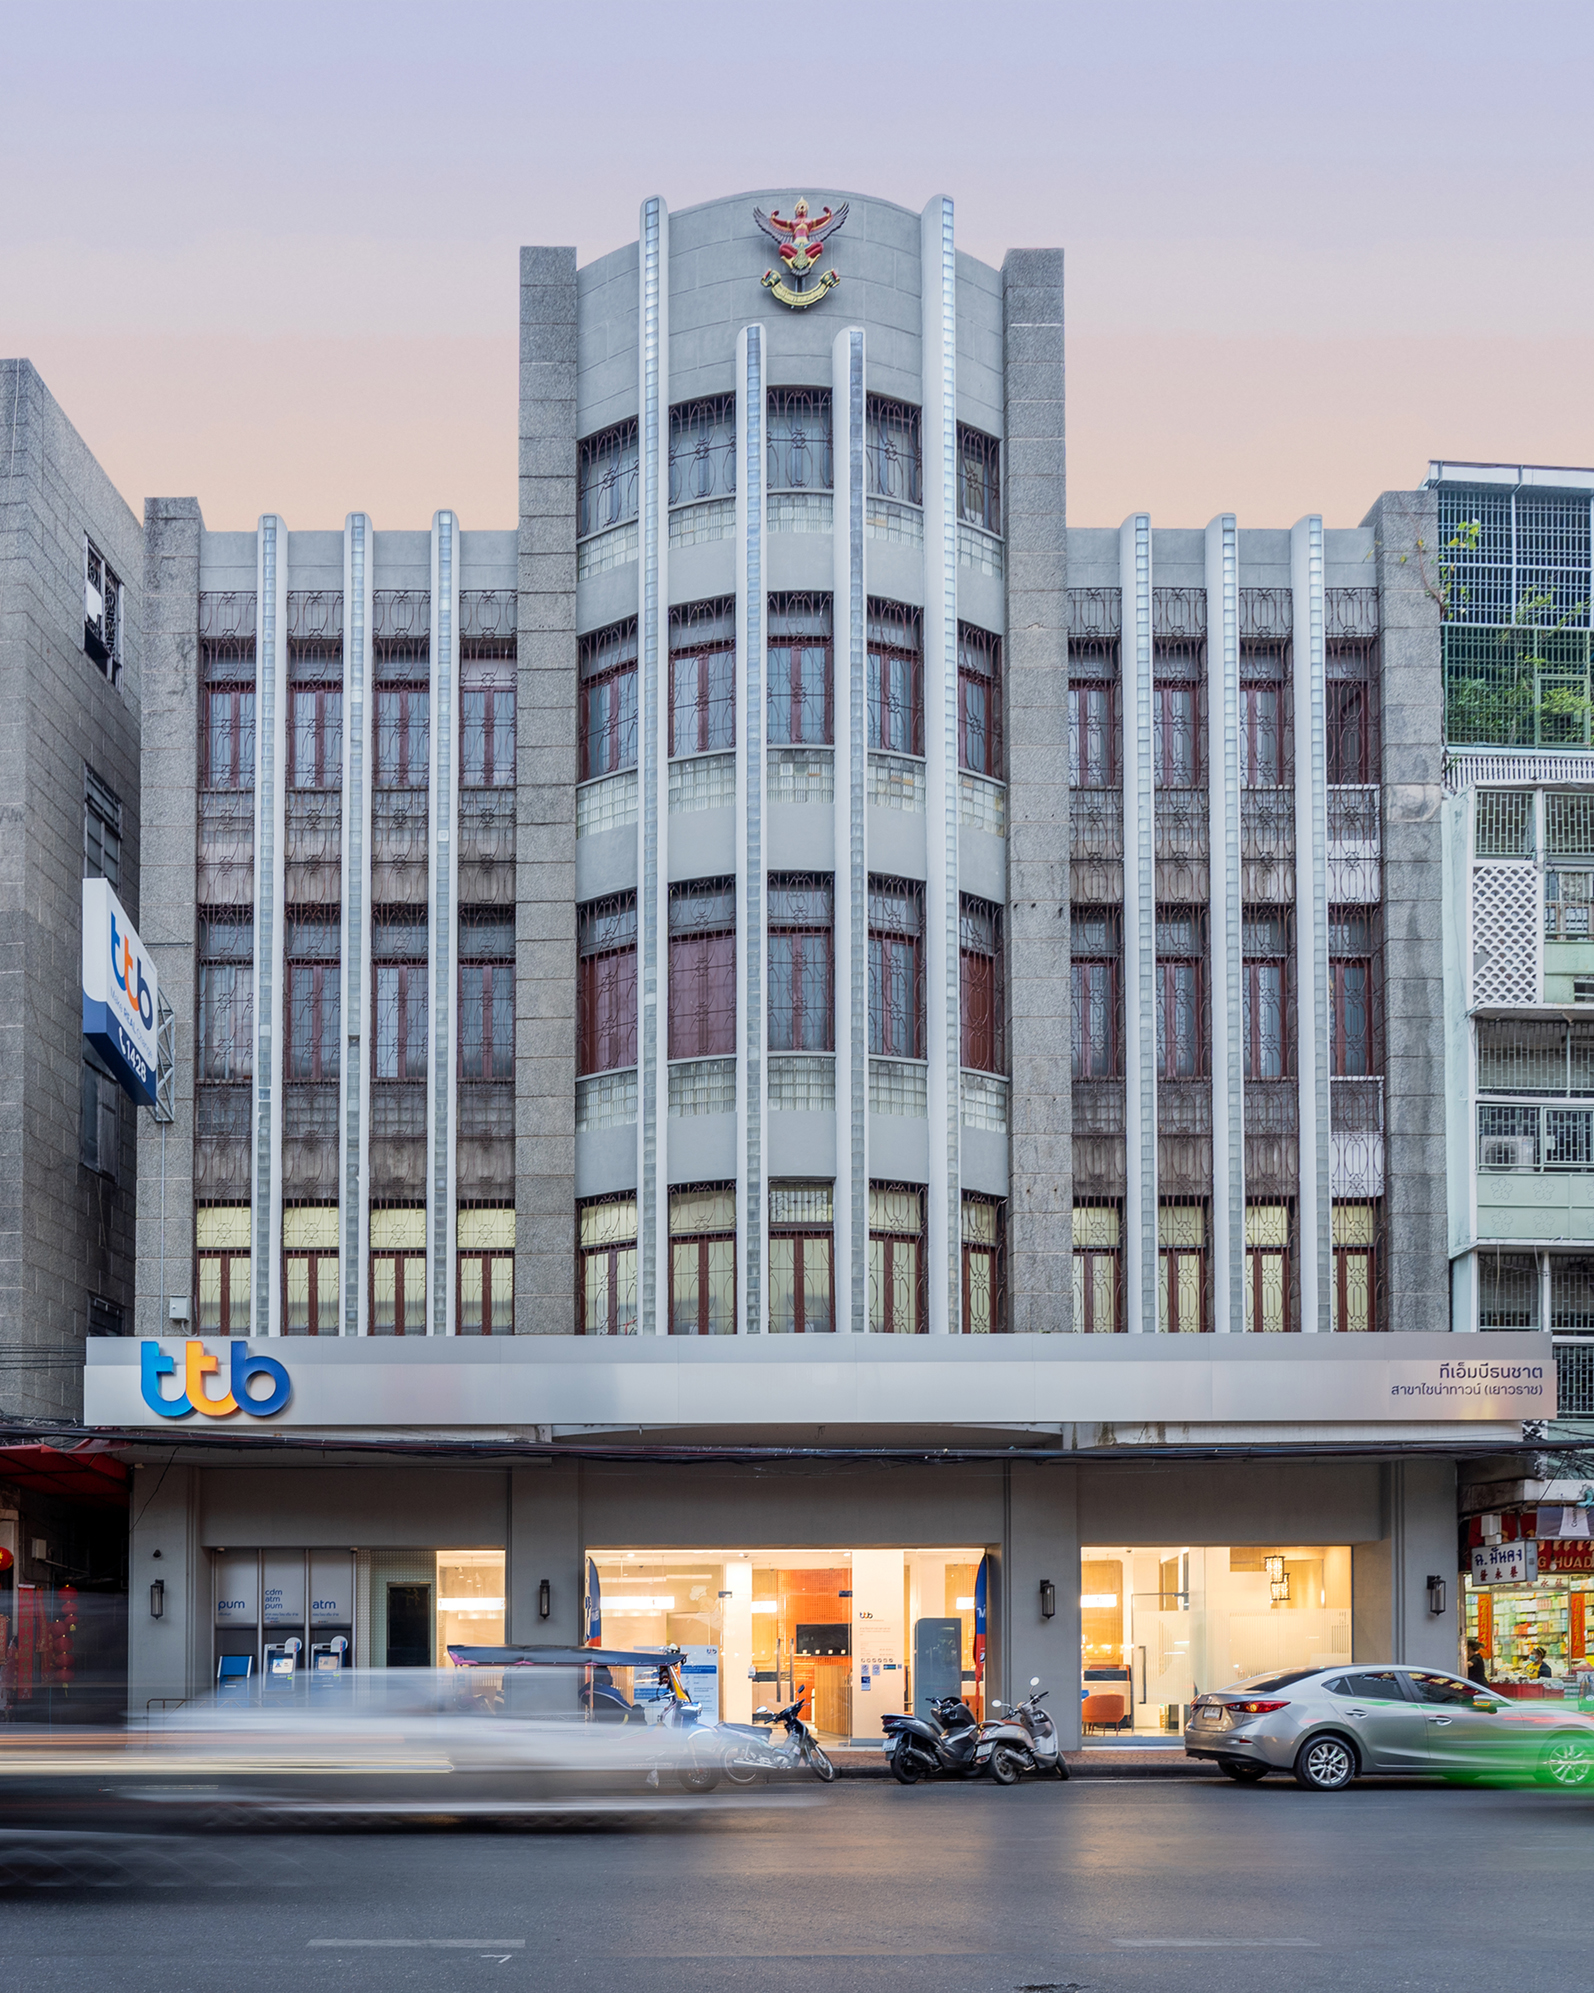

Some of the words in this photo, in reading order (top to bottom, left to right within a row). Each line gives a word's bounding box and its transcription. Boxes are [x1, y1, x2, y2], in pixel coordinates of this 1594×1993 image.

[110, 910, 153, 1031] ttb
[126, 1040, 147, 1083] 1428
[1439, 1361, 1543, 1379] ทีเอ็มบีธนชาต
[141, 1341, 291, 1416] ttb
[1391, 1382, 1481, 1396] สาขาไชน่าทาวน์
[1484, 1384, 1543, 1396] (เยาวราช)
[265, 1588, 283, 1596] cdm
[218, 1600, 245, 1611] pum
[312, 1600, 336, 1609] atm
